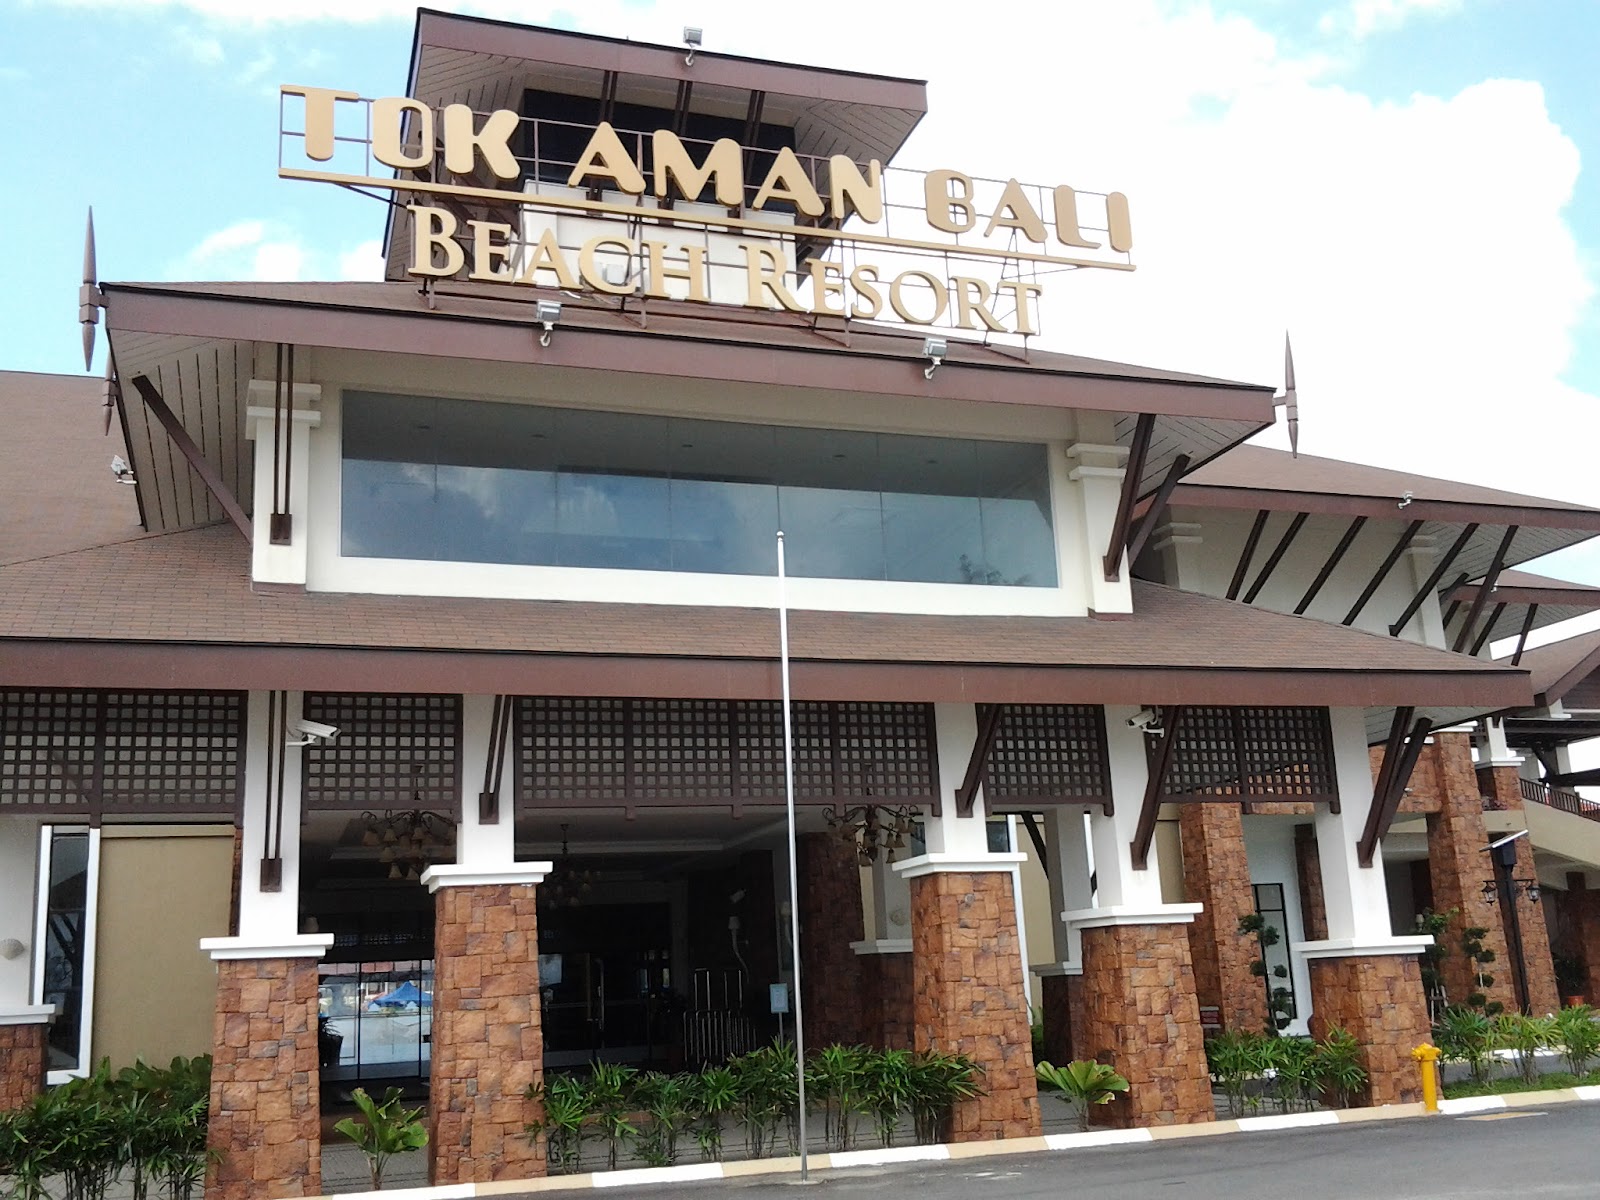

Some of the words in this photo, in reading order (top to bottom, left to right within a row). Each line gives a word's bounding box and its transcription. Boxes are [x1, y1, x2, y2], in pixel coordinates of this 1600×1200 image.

[279, 84, 521, 181] TOK
[567, 121, 884, 225] AMAN
[924, 168, 1133, 253] BALI
[407, 203, 709, 302] BEACH
[738, 243, 1043, 335] RESORT
